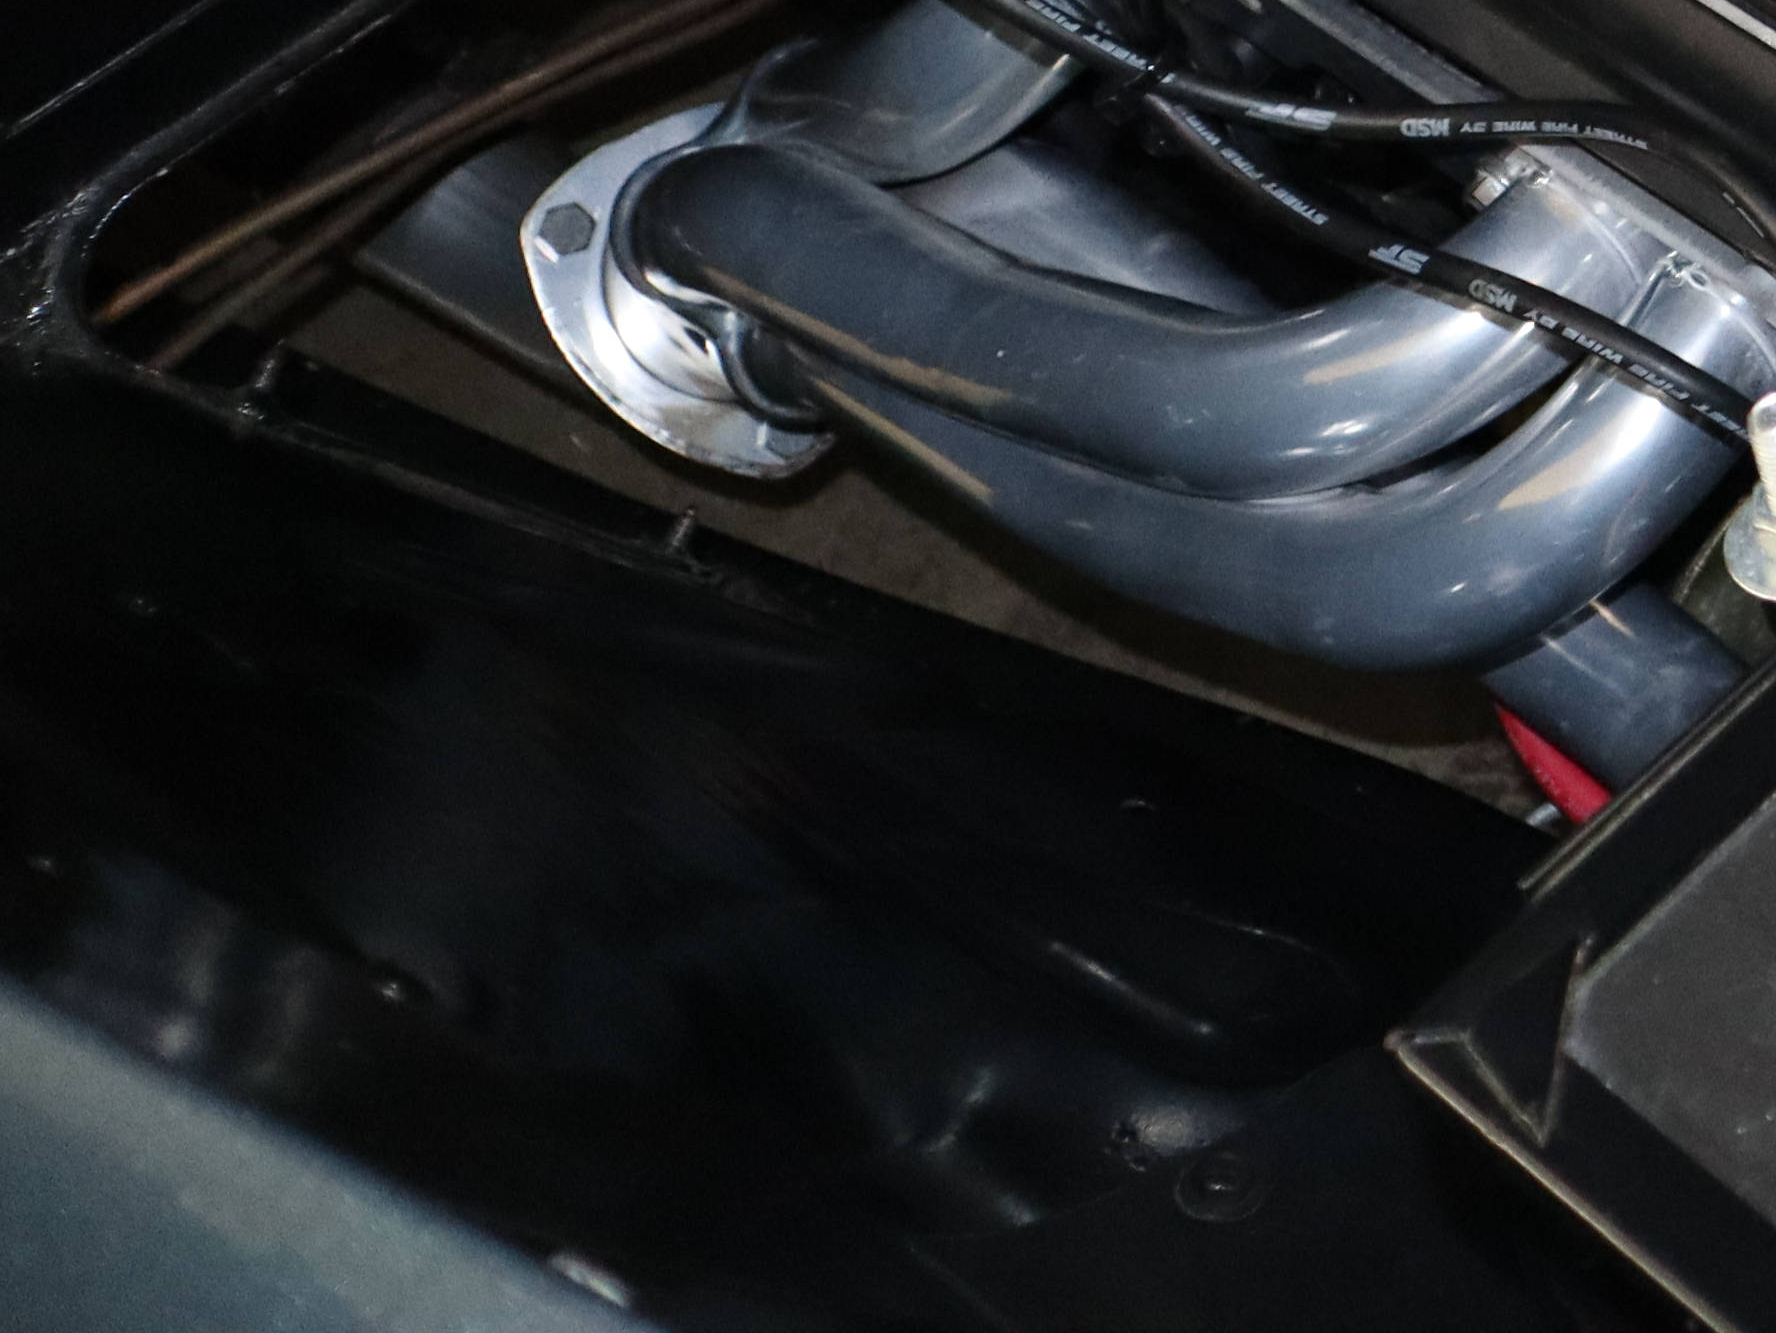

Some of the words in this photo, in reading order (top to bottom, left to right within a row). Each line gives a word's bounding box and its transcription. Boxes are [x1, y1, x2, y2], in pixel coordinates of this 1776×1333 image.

[1400, 117, 1451, 138] MSD
[1492, 120, 1537, 136] WIRE
[1218, 146, 1265, 181] FIRE
[1260, 180, 1331, 226] STREET
[1367, 242, 1432, 277] ST
[1468, 277, 1518, 314] MSD
[1523, 308, 1559, 332] BY
[1563, 325, 1625, 365] WIRE
[1628, 363, 1690, 403] FIRE
